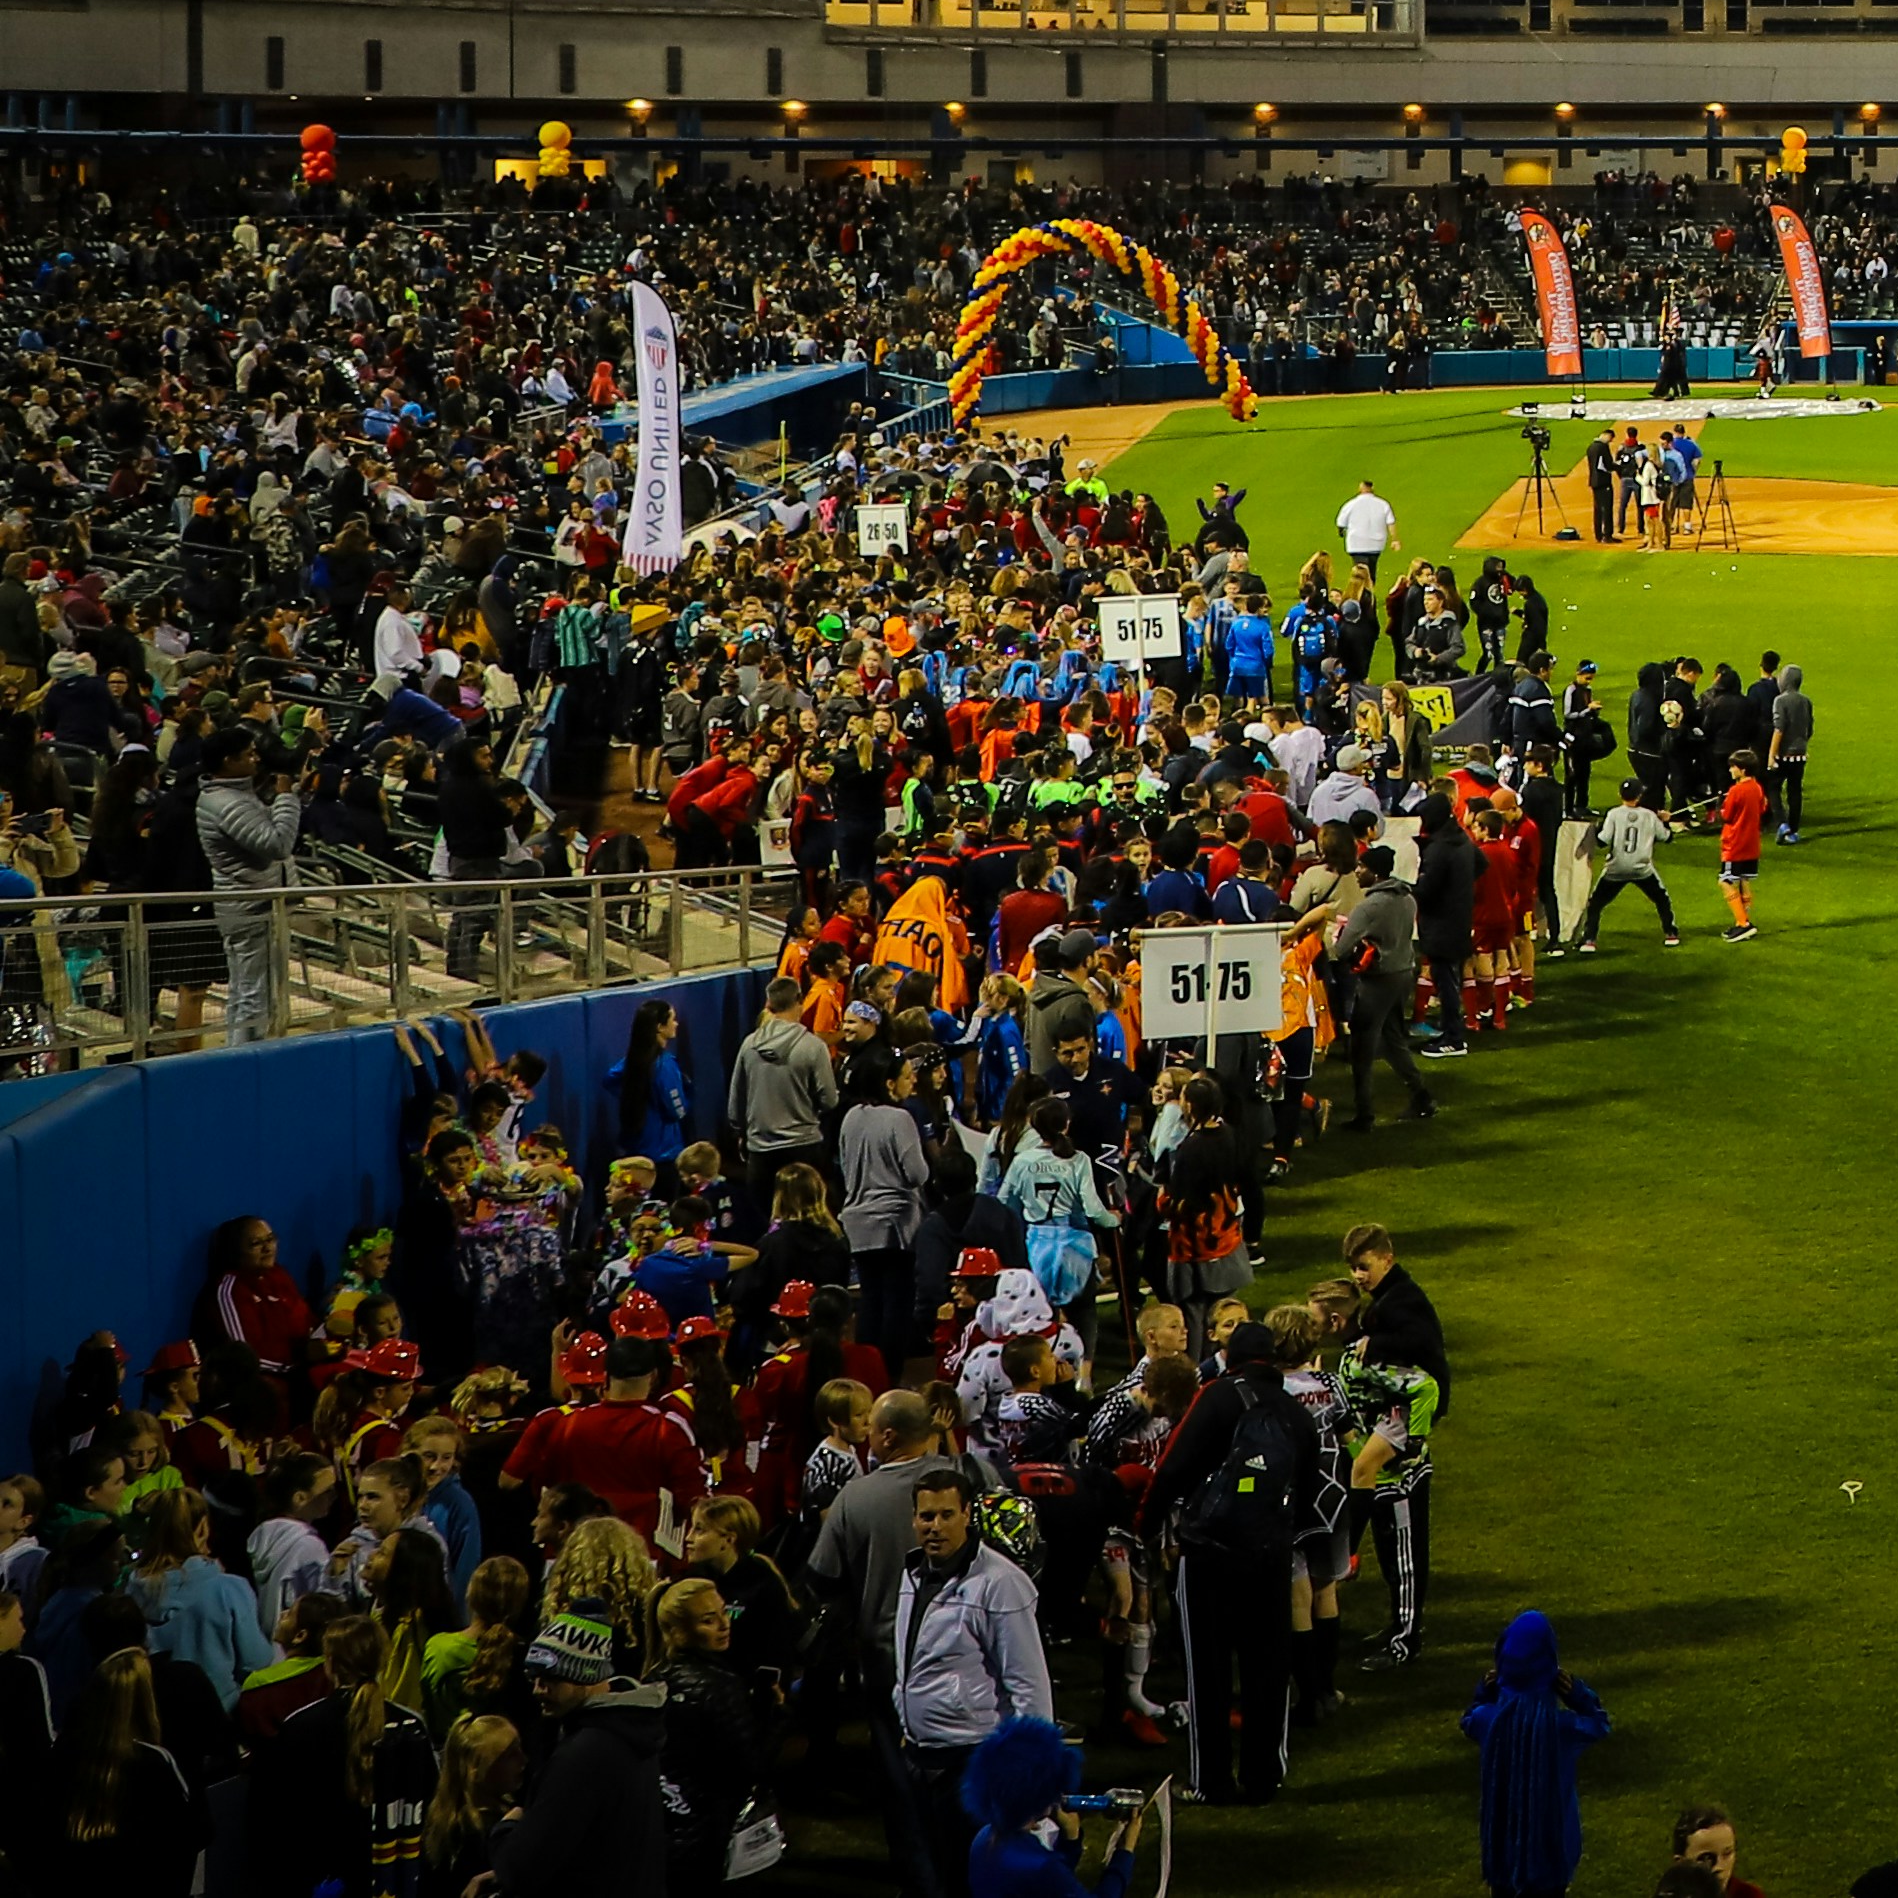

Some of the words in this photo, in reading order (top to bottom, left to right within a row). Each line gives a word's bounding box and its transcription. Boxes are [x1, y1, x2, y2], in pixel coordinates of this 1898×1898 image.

[867, 523, 898, 540] 2650
[1117, 617, 1162, 641] 5175
[1624, 827, 1638, 853] 9
[1034, 1182, 1061, 1220] 7
